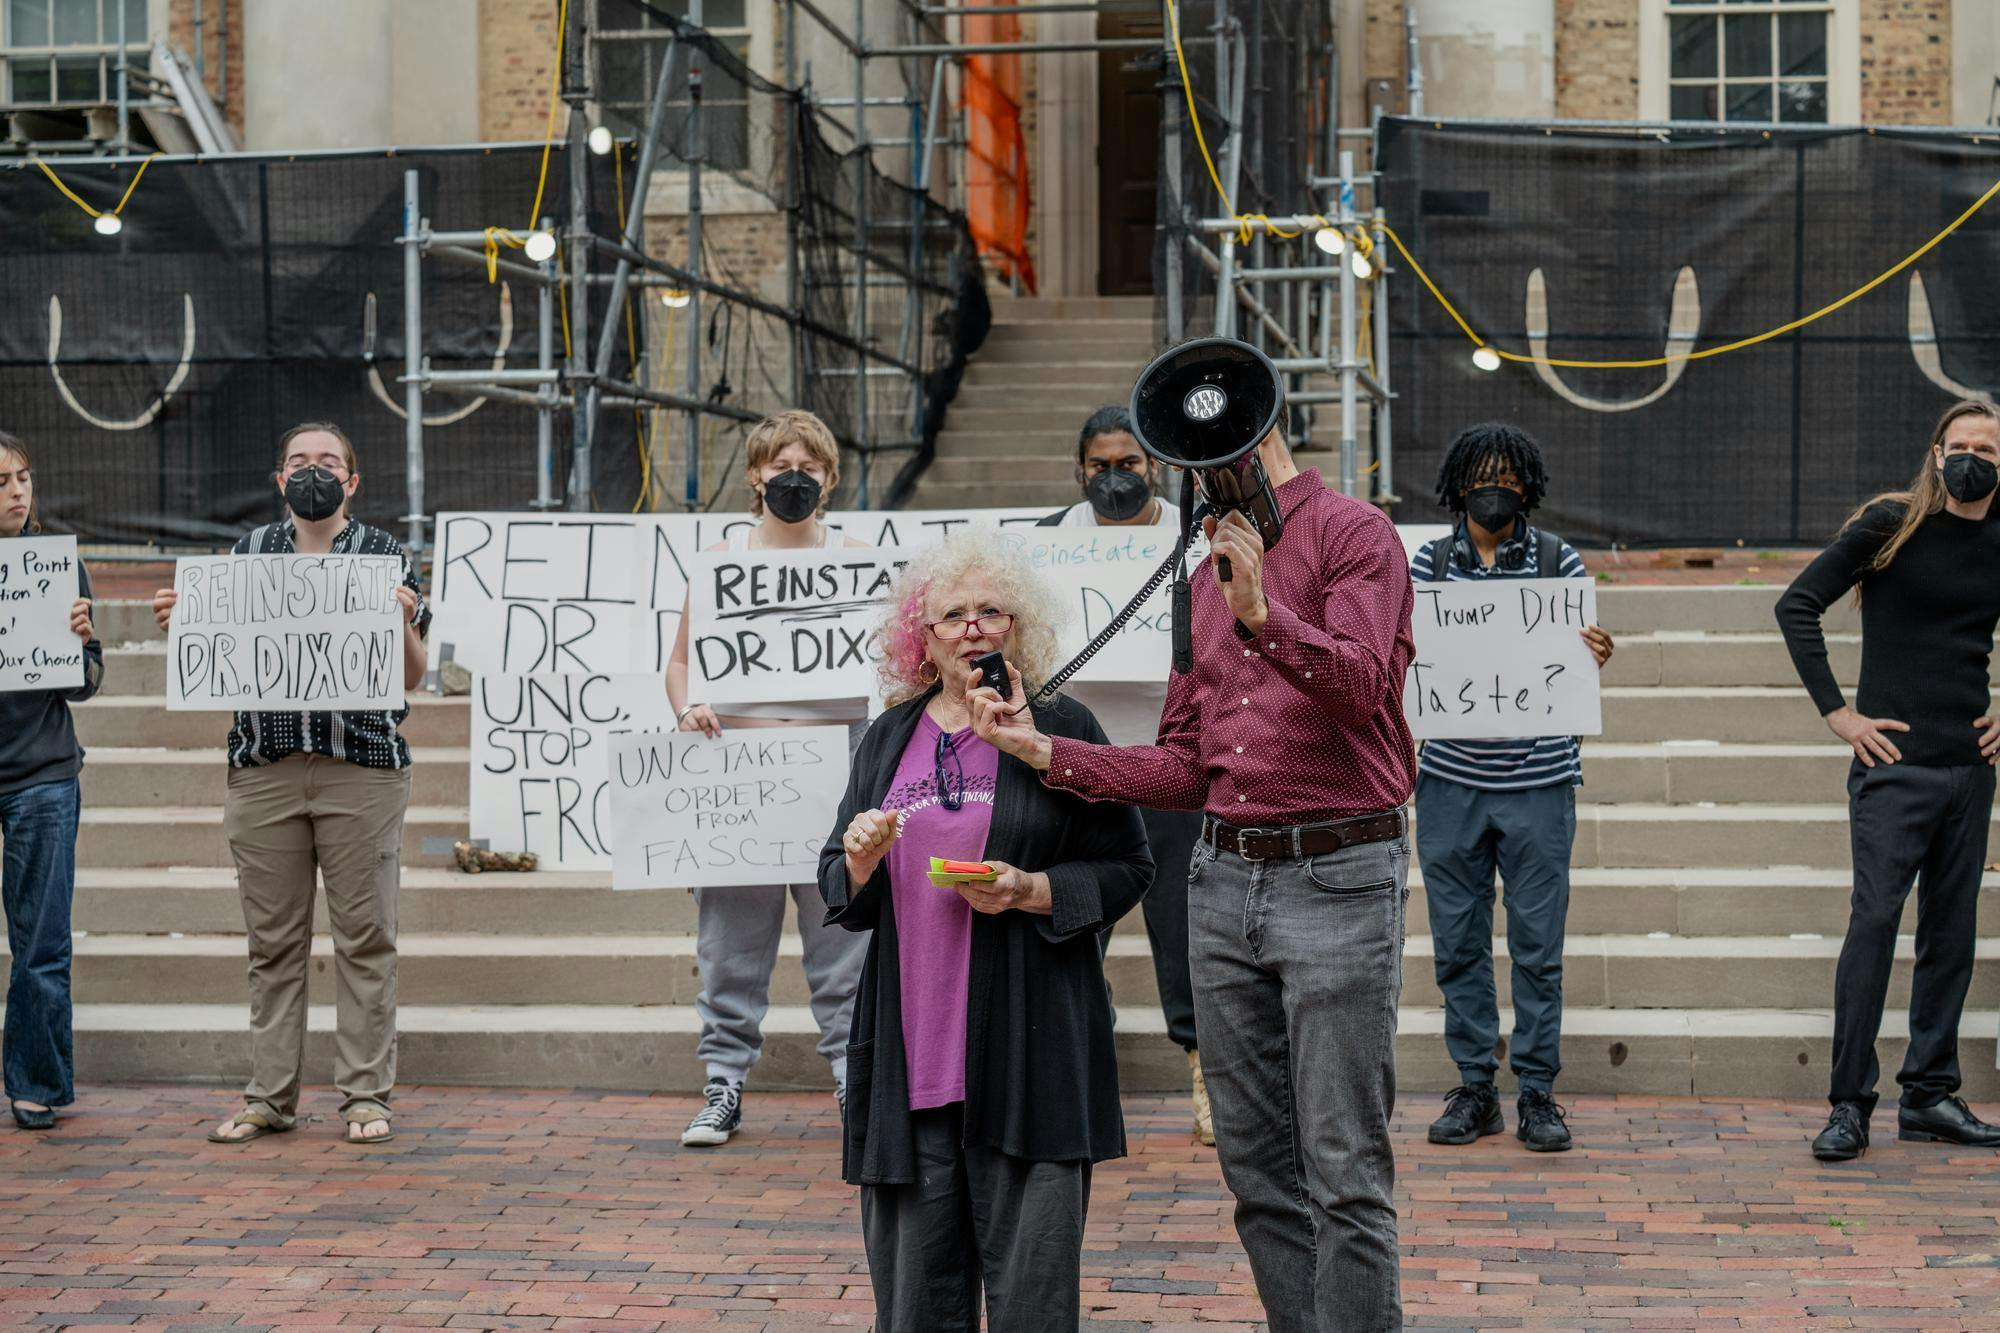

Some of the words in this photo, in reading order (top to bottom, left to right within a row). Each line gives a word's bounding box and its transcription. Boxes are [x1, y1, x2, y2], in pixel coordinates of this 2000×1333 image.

[23, 550, 72, 575] Point
[181, 556, 399, 625] REINSTATE
[695, 630, 781, 681] DR.
[484, 727, 592, 774] STOP
[619, 741, 709, 788] UNC
[714, 740, 823, 775] TAKES
[665, 778, 802, 814] ORDERS
[908, 799, 931, 812] FOR
[694, 808, 759, 830] FROM
[642, 834, 828, 876] FASCIS
